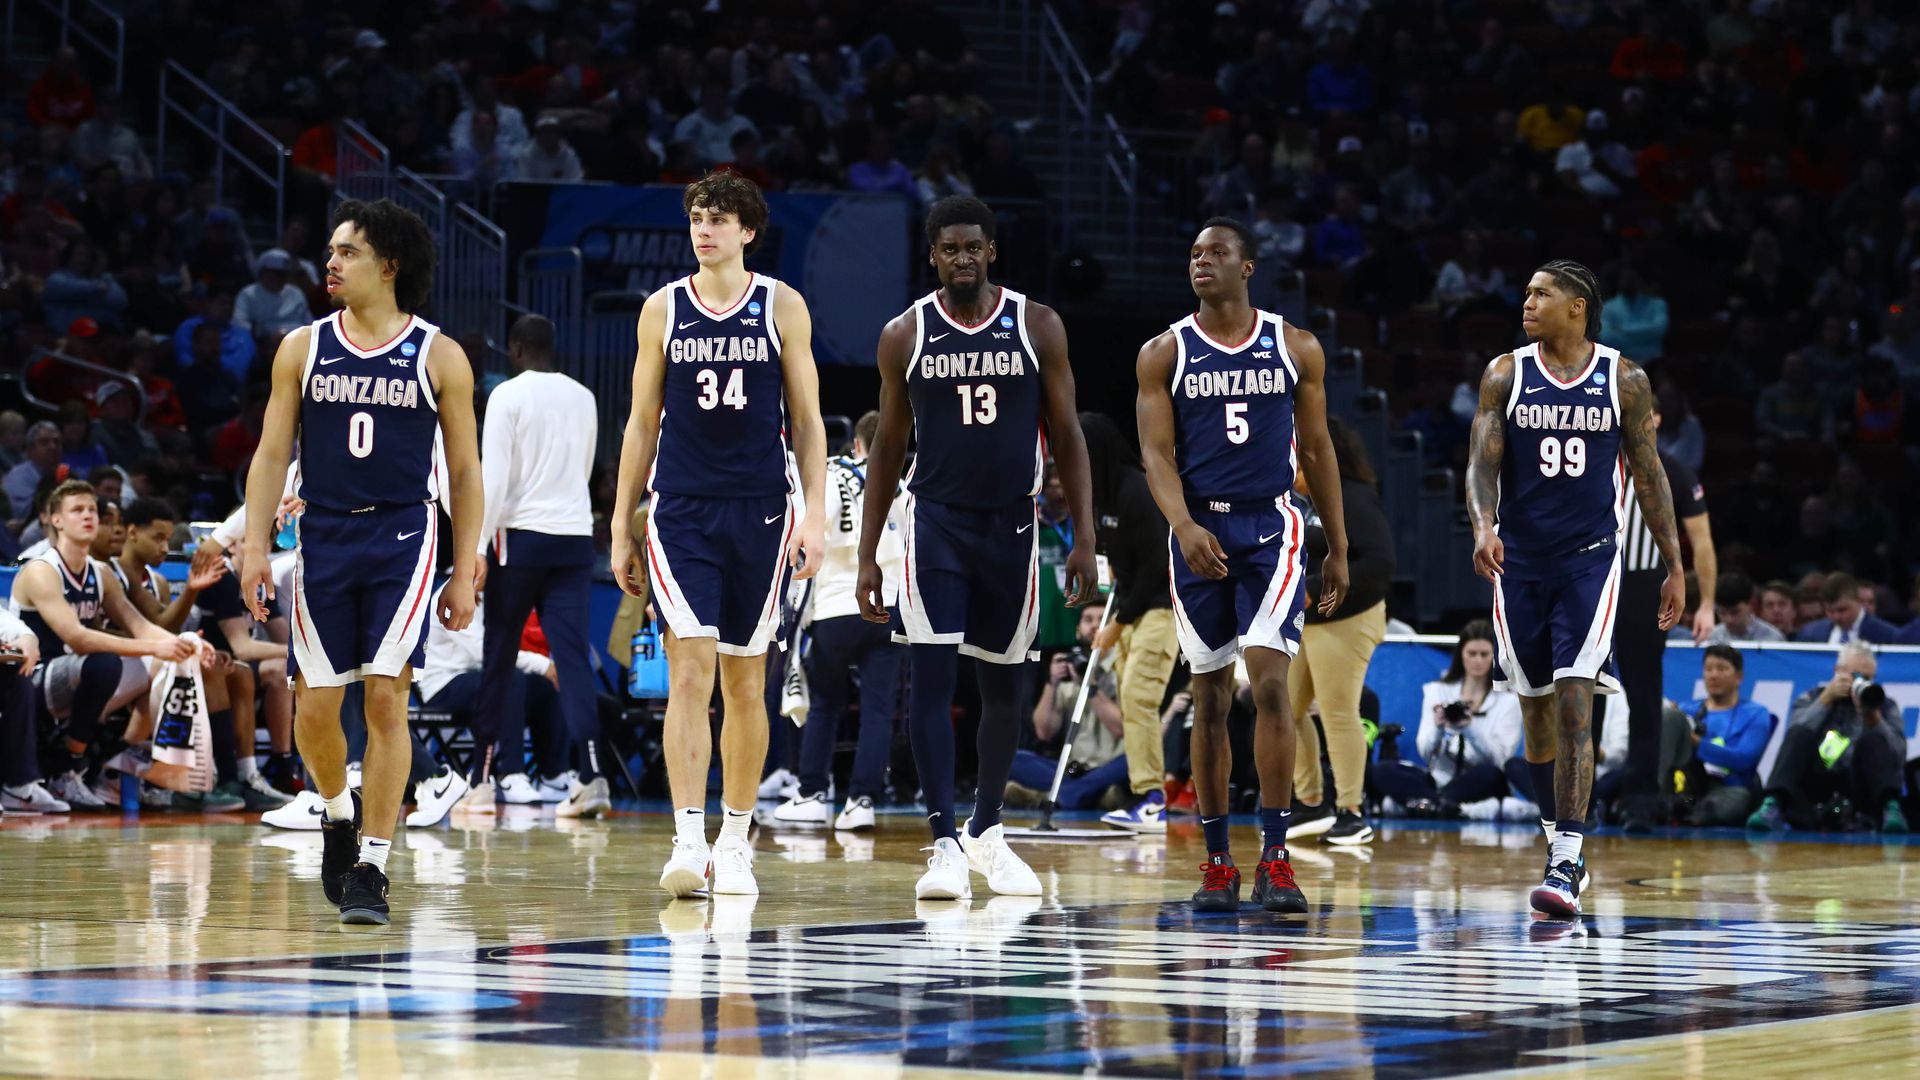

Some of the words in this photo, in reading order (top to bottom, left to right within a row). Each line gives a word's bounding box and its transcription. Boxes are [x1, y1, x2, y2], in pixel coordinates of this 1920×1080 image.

[670, 336, 769, 364] GONZAGA
[921, 351, 1025, 379] GONZAGA
[311, 374, 418, 409] GONZAGA
[696, 368, 748, 411] 34
[1184, 368, 1286, 399] GONZAGA
[957, 383, 997, 425] 13
[1515, 403, 1613, 432] GONZAGA
[348, 411, 375, 459] 0
[1225, 402, 1250, 445] 5
[1539, 436, 1586, 478] 99
[1209, 500, 1231, 513] ZAGS
